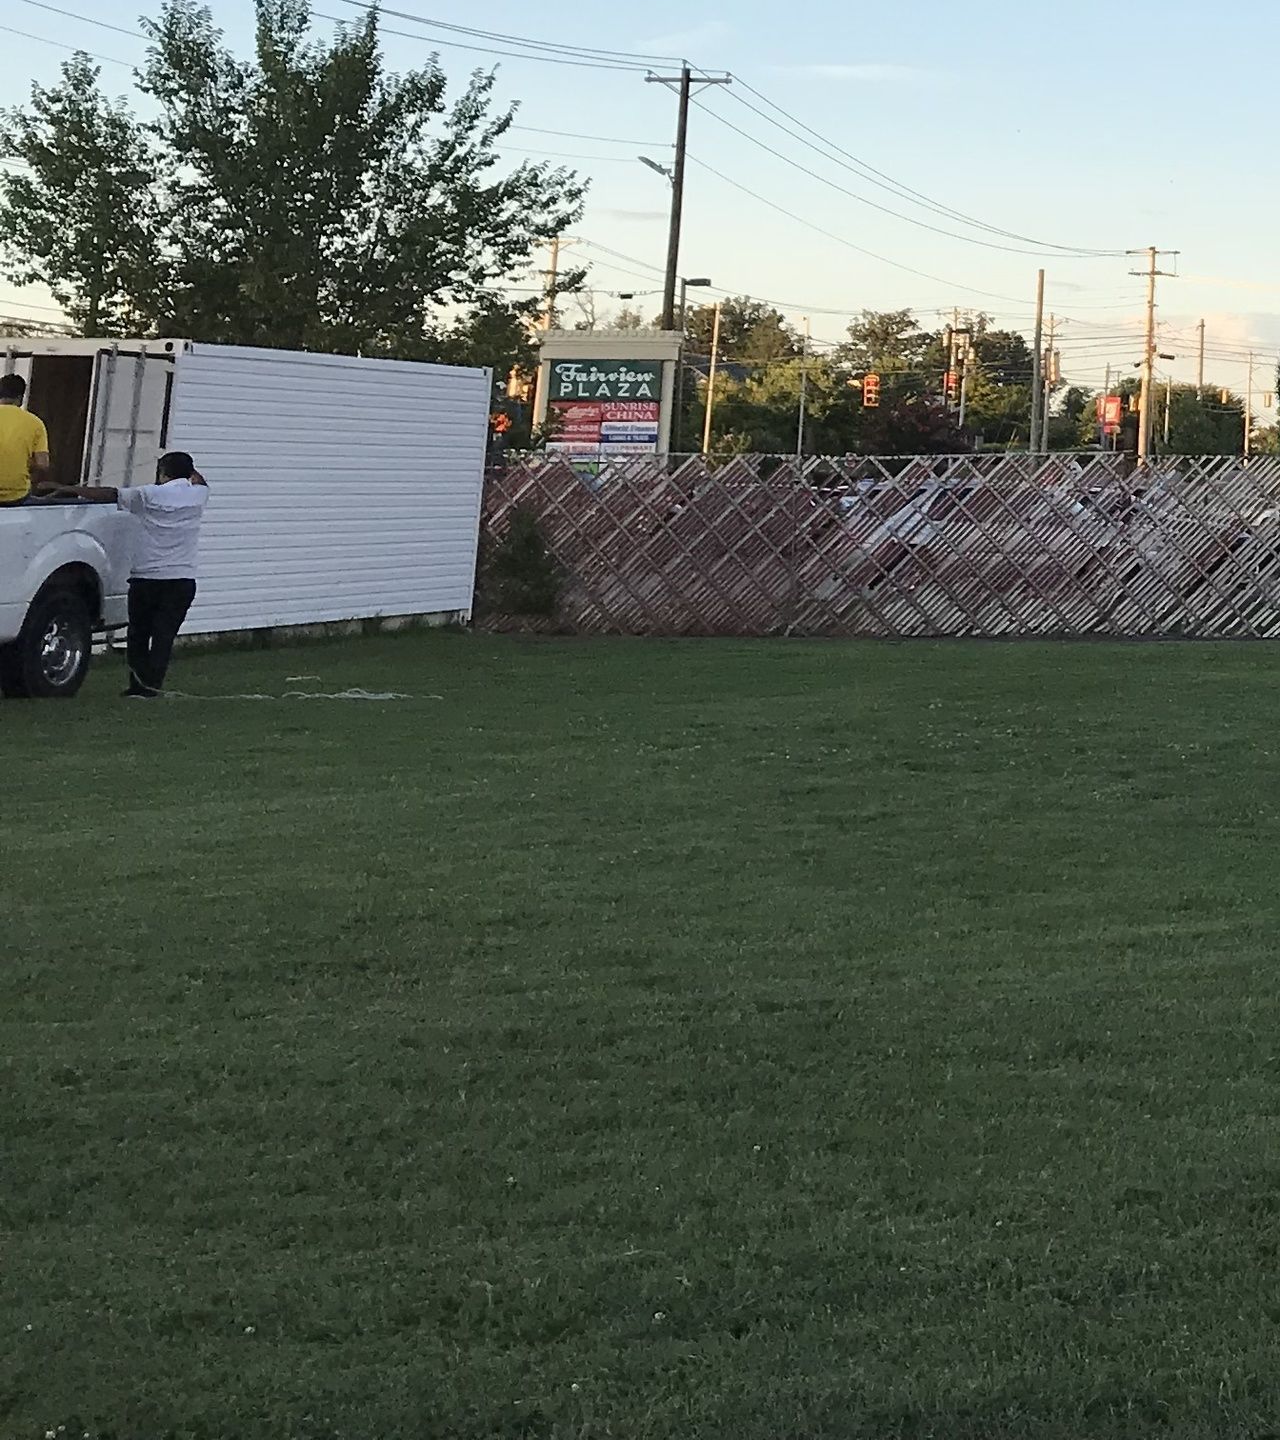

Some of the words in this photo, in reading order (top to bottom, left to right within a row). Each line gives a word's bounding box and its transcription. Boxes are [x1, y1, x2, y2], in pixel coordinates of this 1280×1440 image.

[555, 363, 656, 382] Fairview
[559, 383, 652, 397] PLAZA
[603, 402, 657, 411] SUNRISE
[606, 411, 654, 420] CHINA
